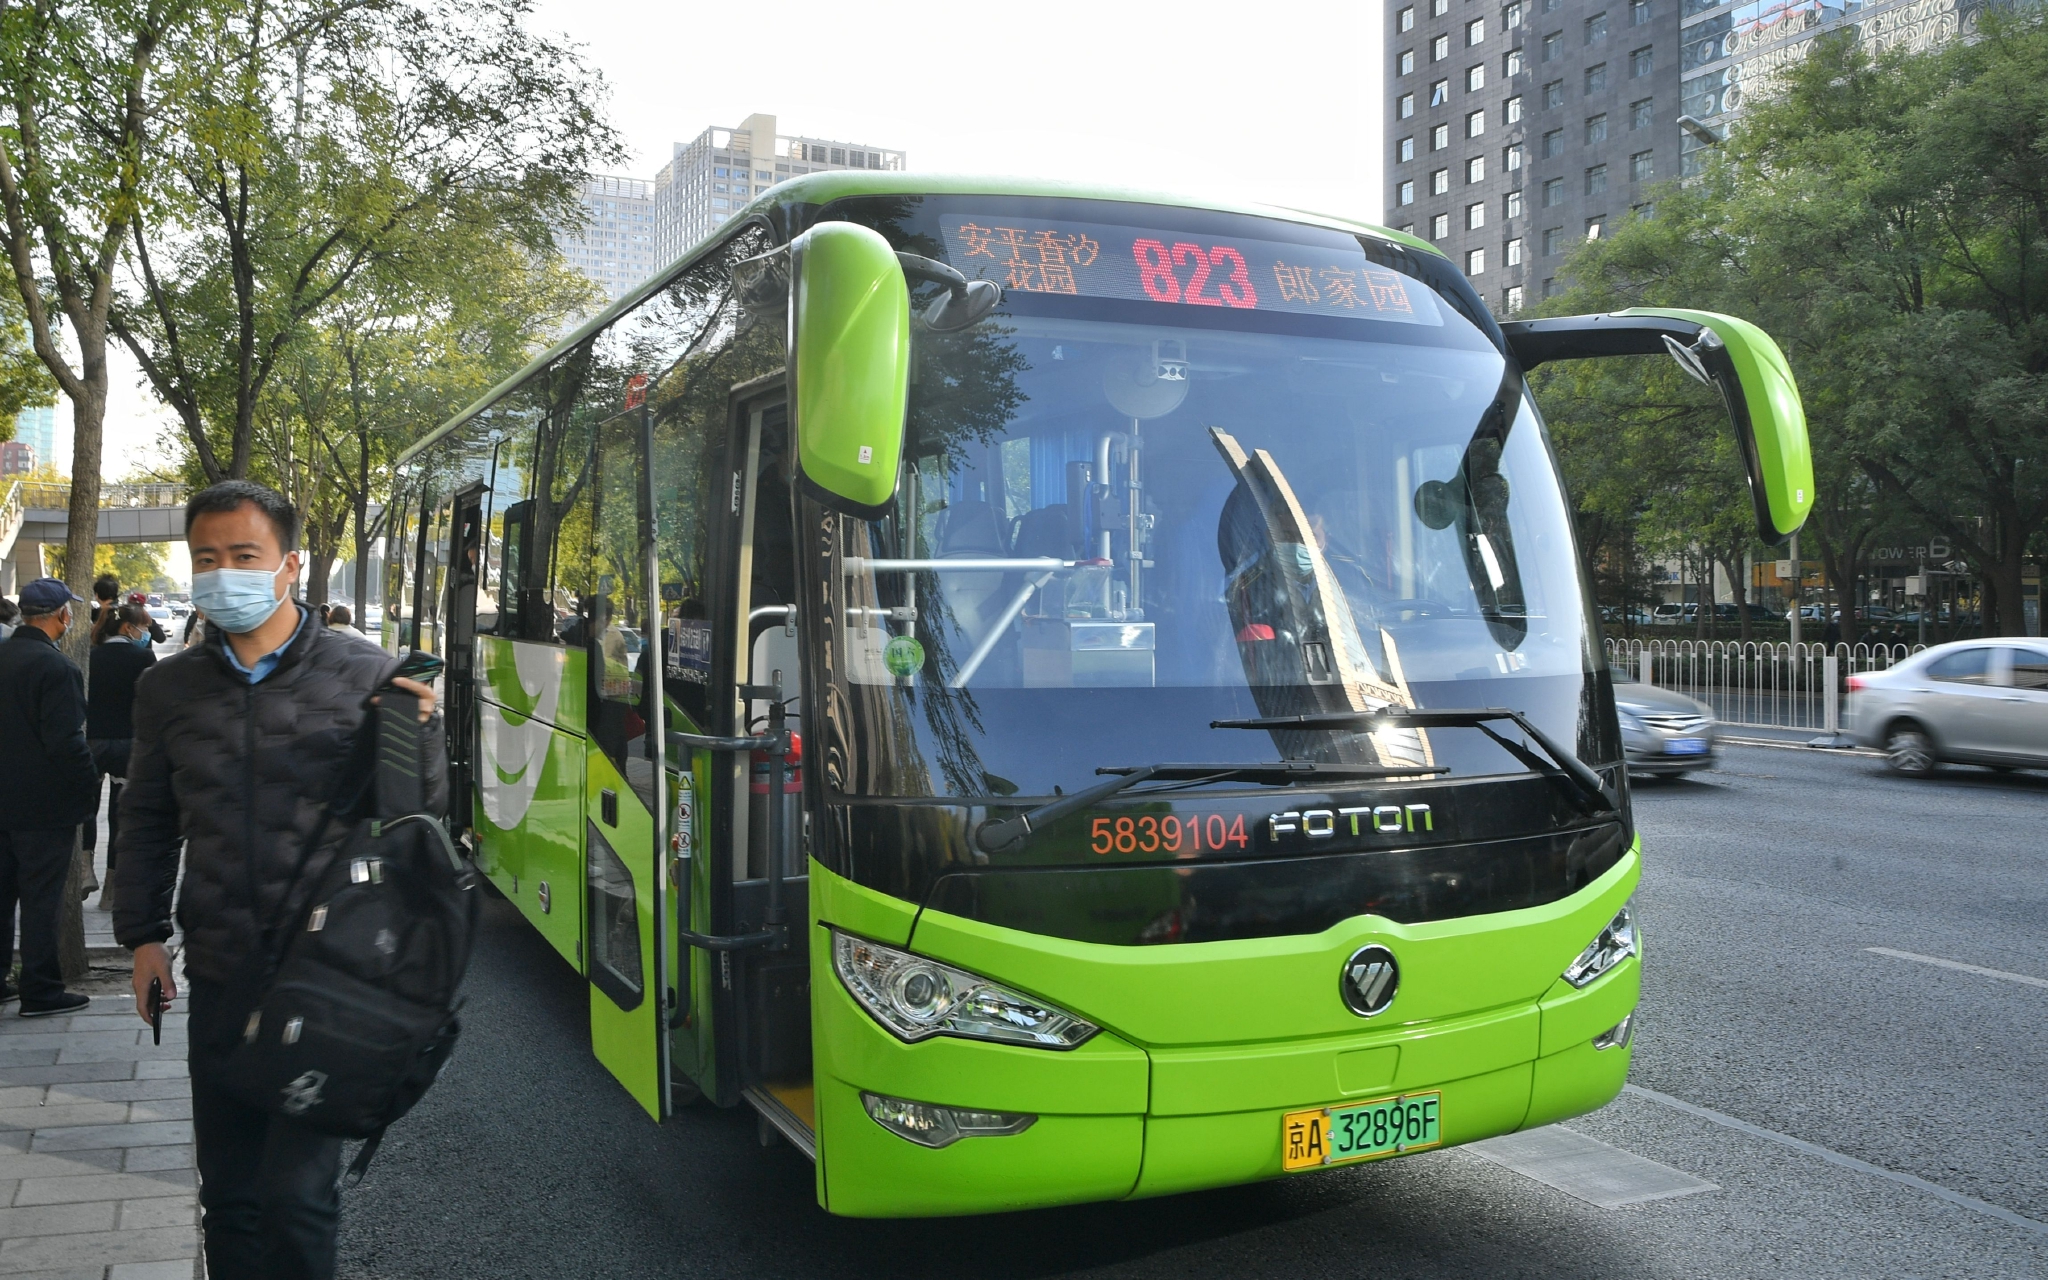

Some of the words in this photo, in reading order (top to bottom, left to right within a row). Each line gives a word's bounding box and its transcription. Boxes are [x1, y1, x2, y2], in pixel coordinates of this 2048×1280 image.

[1001, 258, 1077, 295] 花园
[1132, 238, 1258, 310] 823
[1273, 260, 1413, 314] 郎家园
[1869, 546, 1927, 560] OWER
[1090, 813, 1249, 855] 5839104
[1268, 803, 1434, 842] FOTON
